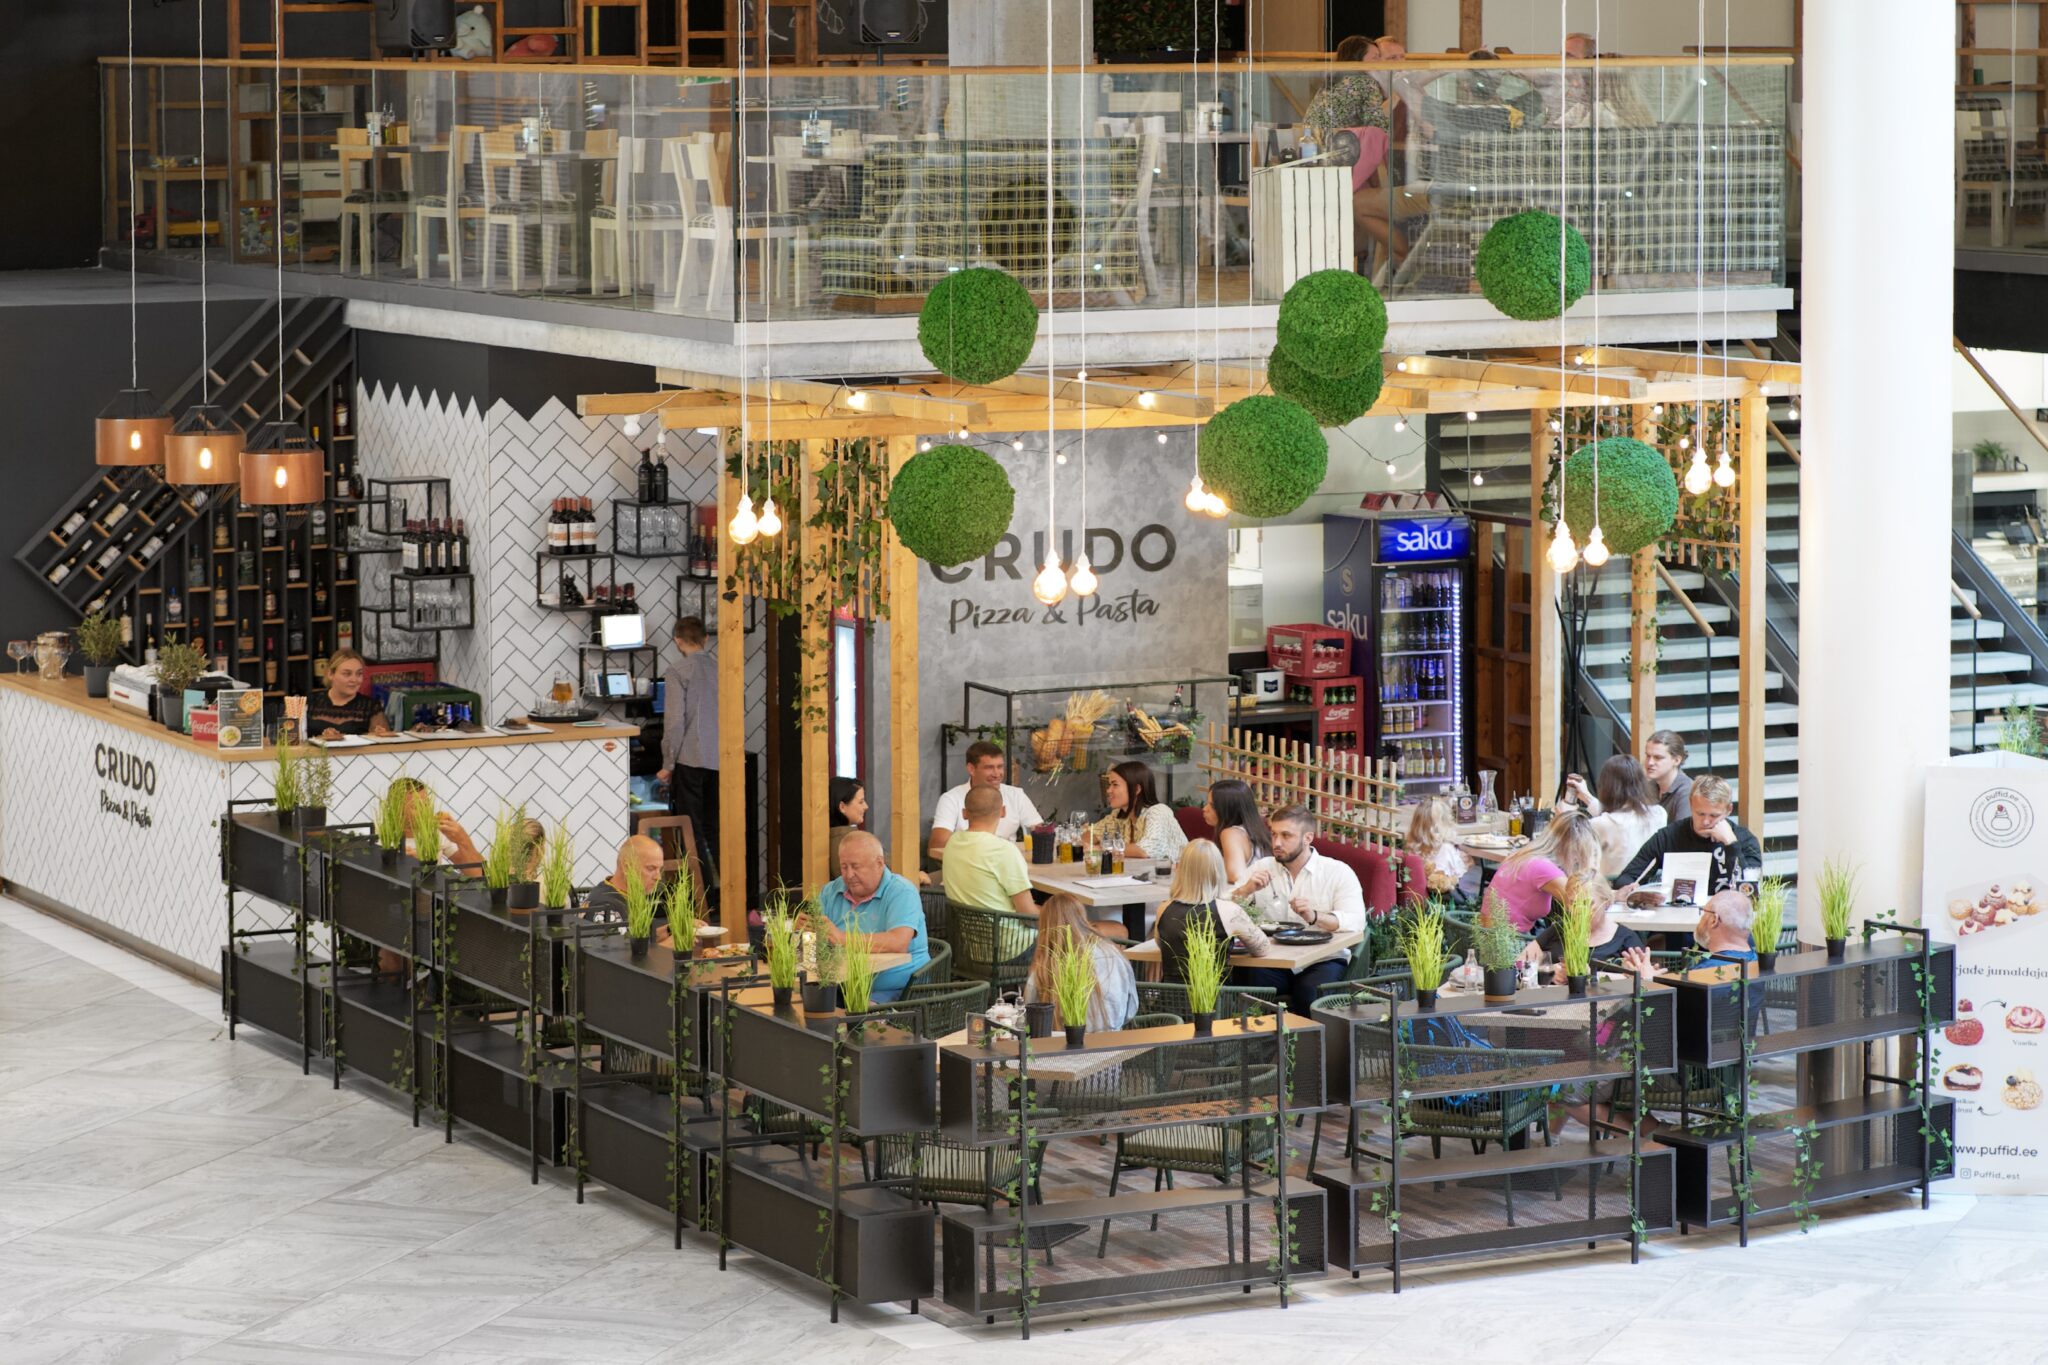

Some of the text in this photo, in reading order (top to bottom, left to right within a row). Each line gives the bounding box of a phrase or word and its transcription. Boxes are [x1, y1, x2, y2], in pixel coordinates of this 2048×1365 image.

[1396, 524, 1453, 552] saku
[949, 589, 1161, 635] Pizza & Pasta
[1327, 603, 1368, 640] saku
[95, 742, 156, 797] CRUDO
[101, 789, 122, 815] Pizza
[131, 801, 152, 830] Pasta
[1955, 1145, 2038, 1157] ww.puffid.ee
